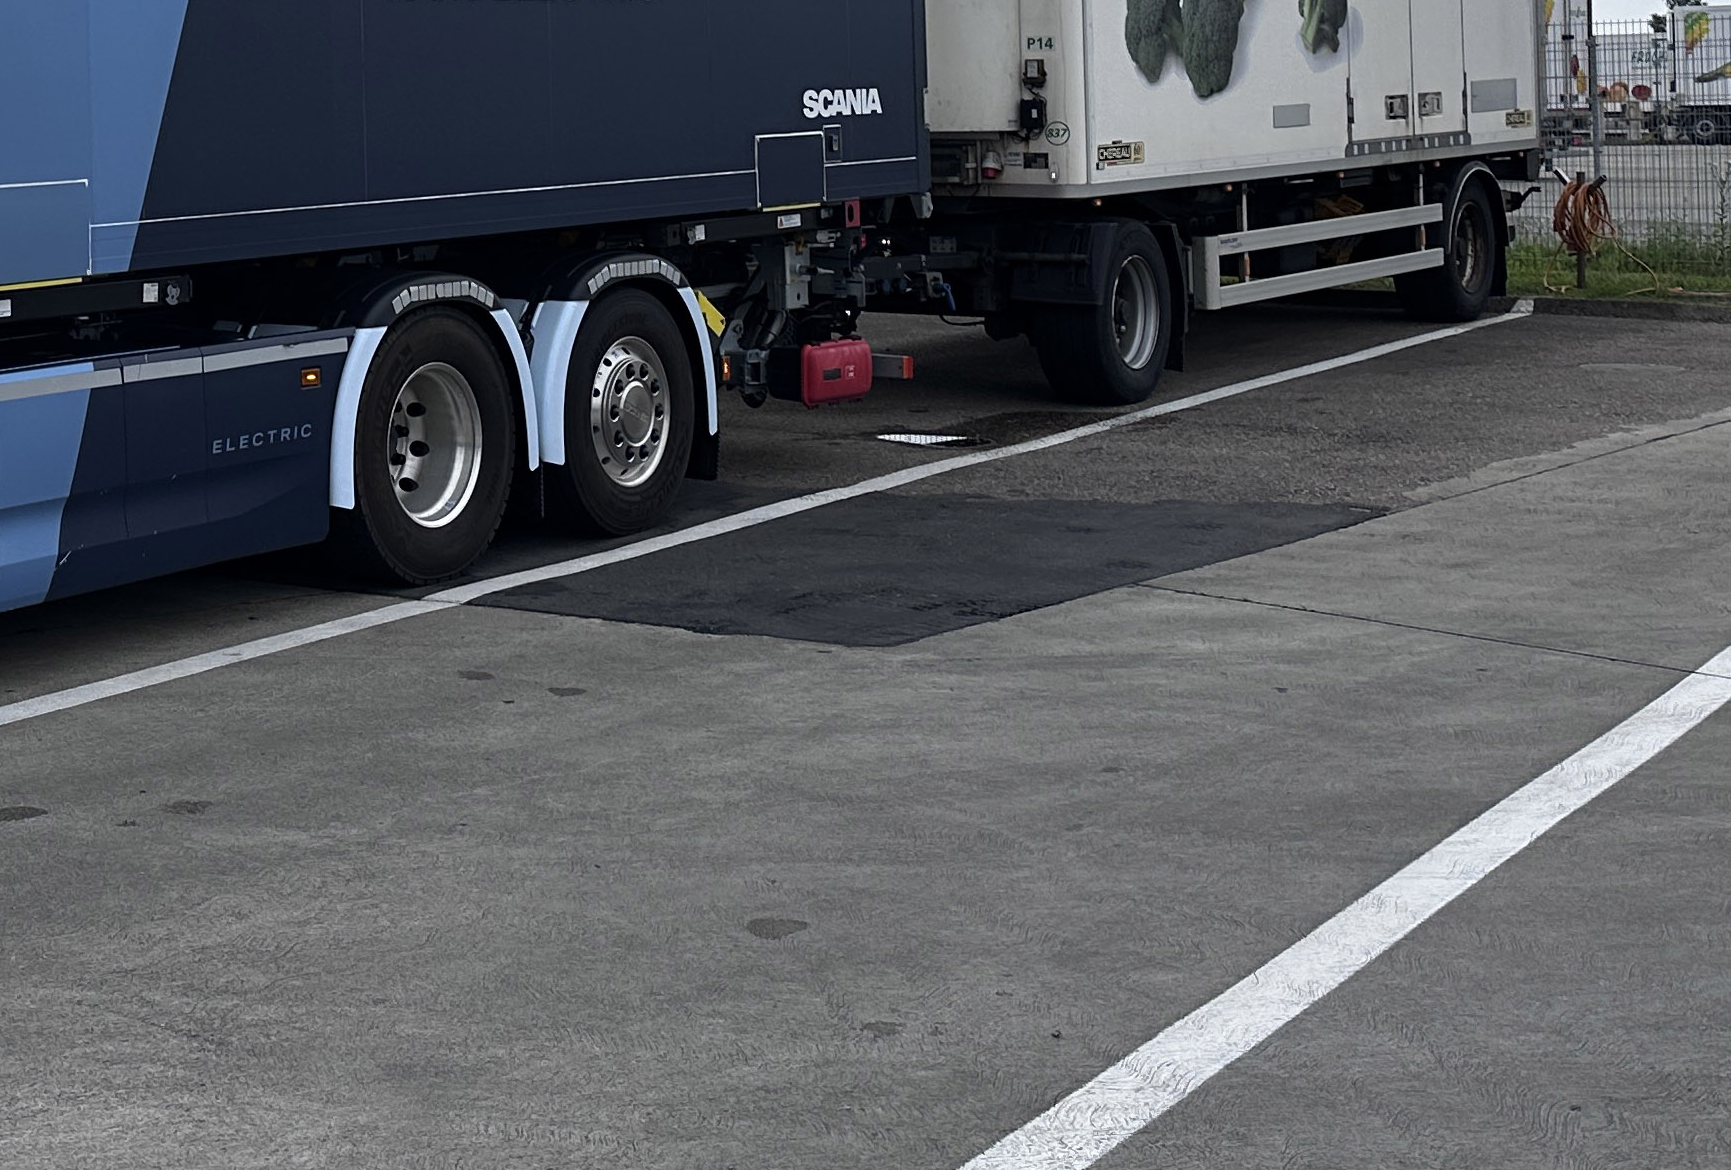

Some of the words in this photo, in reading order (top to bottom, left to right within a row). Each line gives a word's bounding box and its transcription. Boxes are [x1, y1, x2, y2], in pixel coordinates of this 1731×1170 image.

[1027, 37, 1054, 50] P14
[802, 88, 883, 119] SCANIA
[1047, 128, 1068, 138] 837
[212, 423, 312, 454] ELECTRIC
